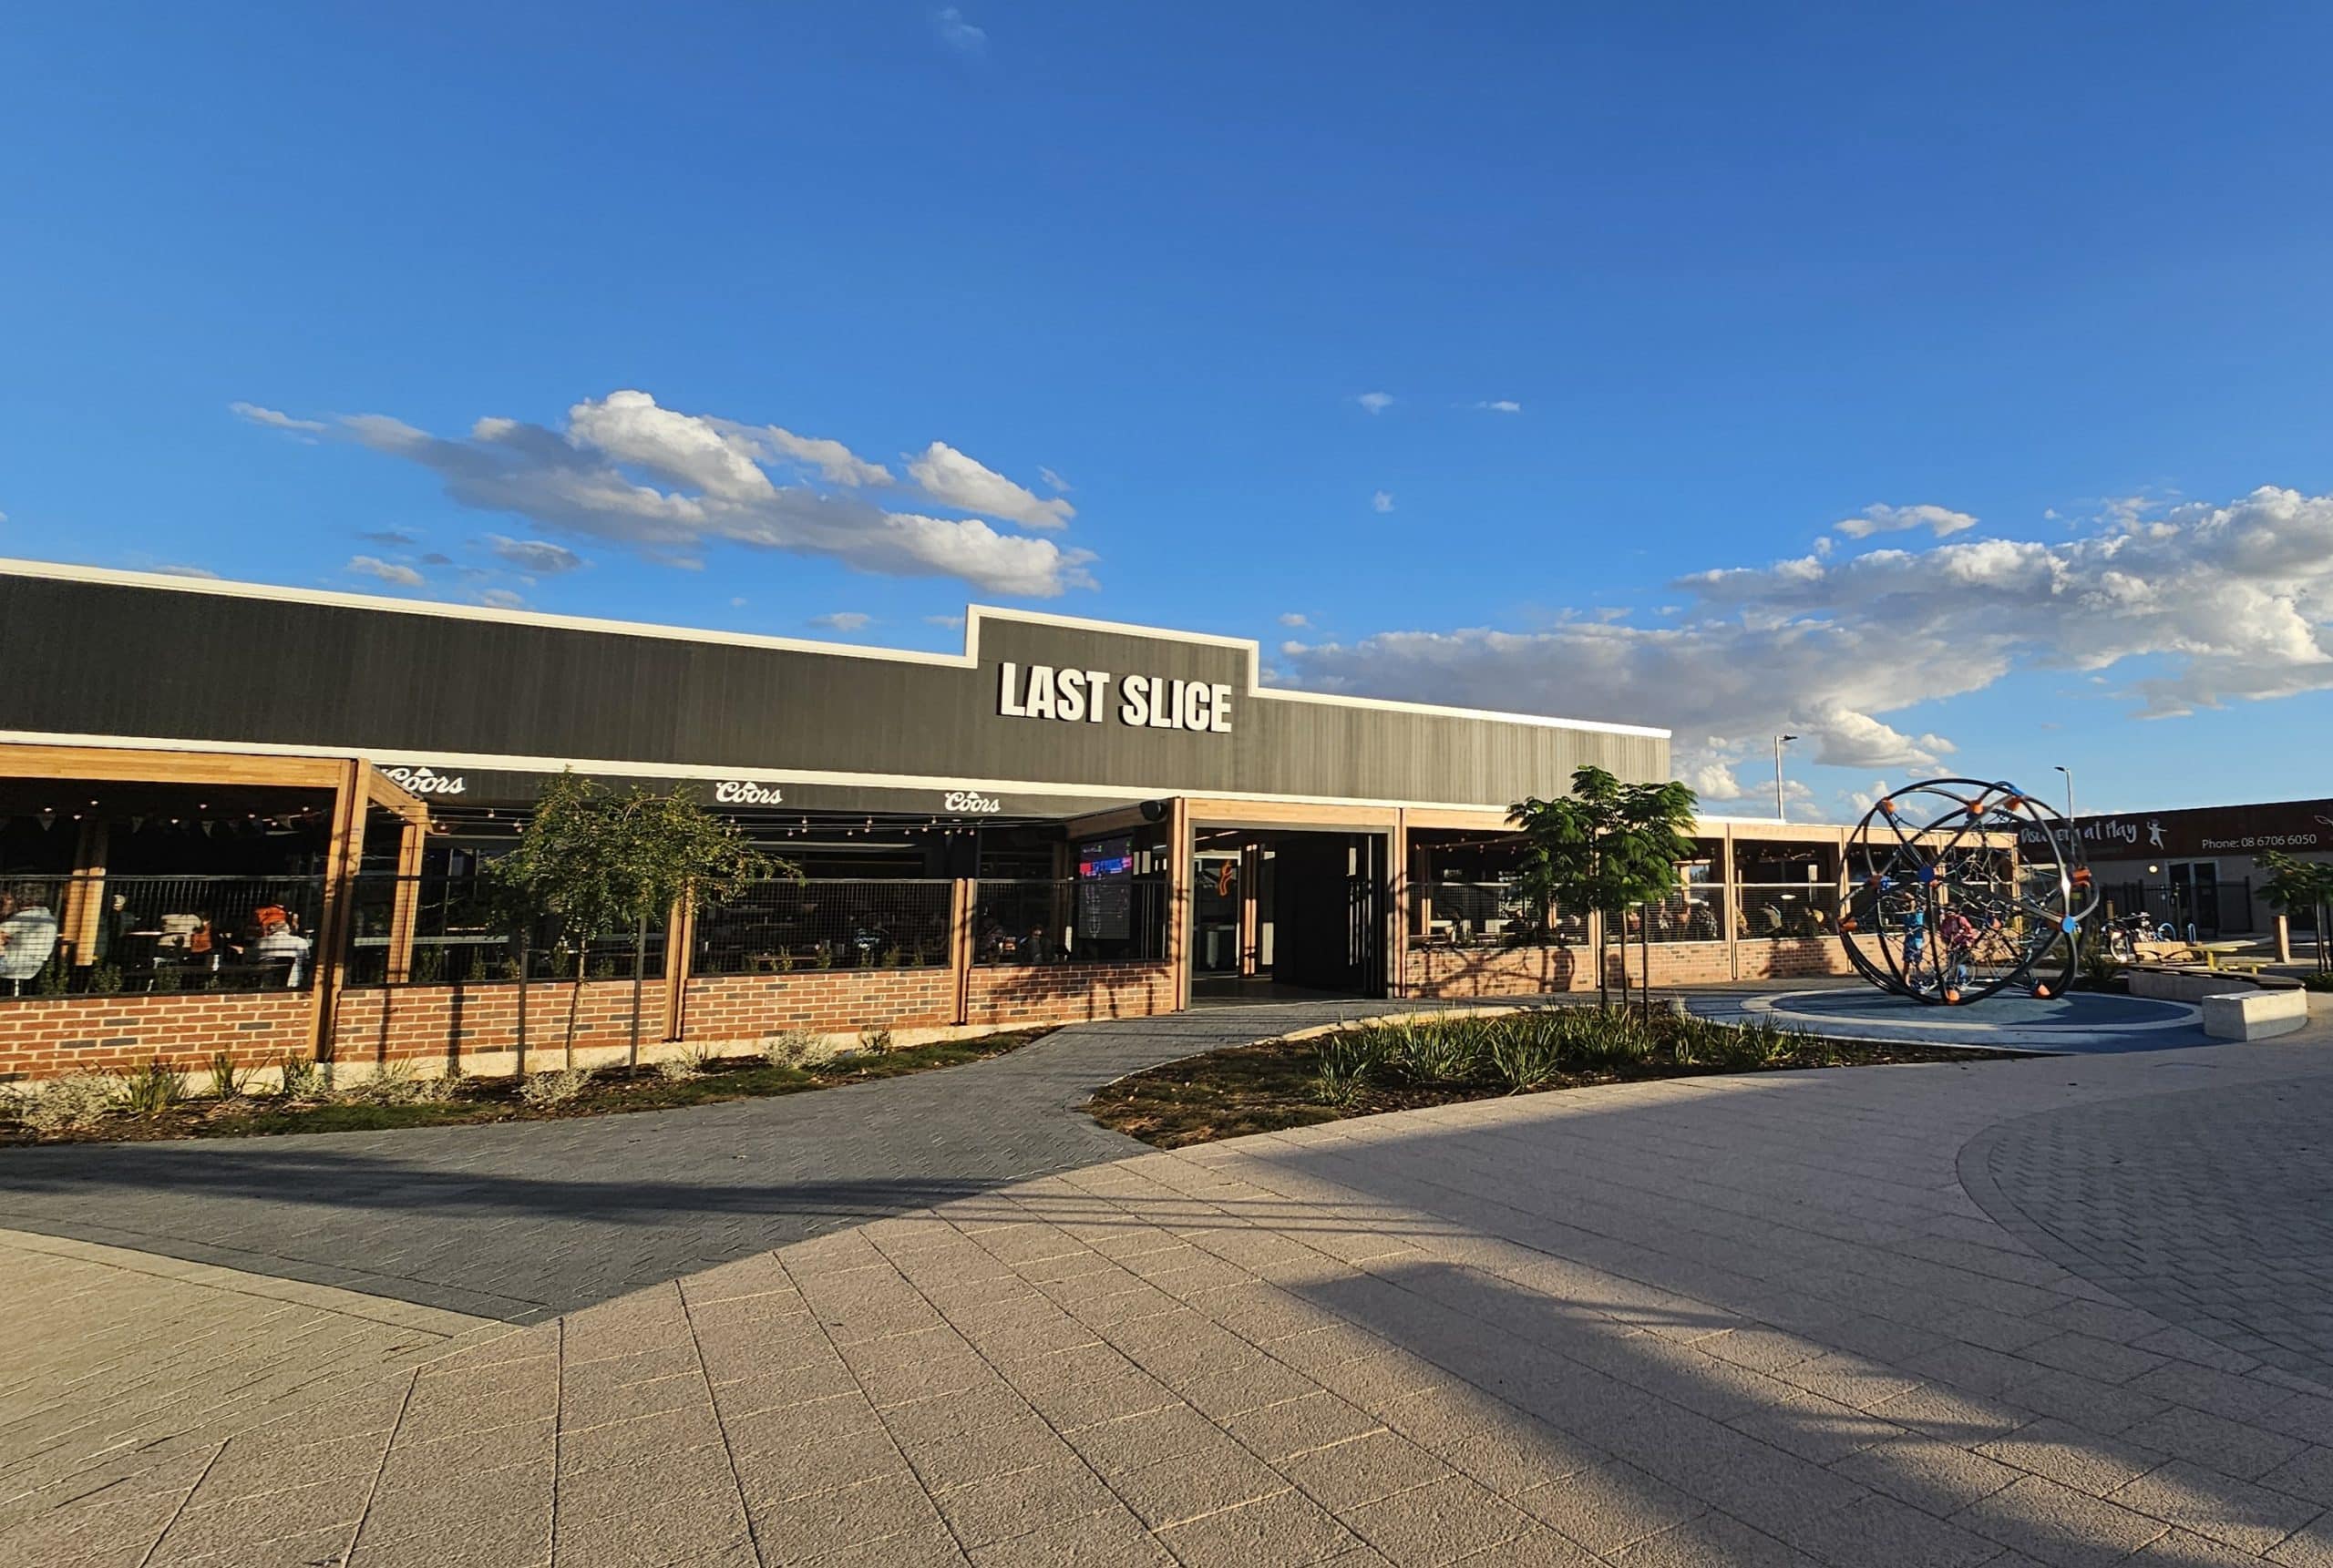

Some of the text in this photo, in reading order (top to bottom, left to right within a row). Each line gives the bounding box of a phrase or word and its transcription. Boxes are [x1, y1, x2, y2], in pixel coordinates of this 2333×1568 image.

[1000, 662, 1231, 733] LAST SLICE
[715, 781, 782, 804] Coors
[945, 791, 1000, 812] Coors
[2084, 822, 2102, 840] at
[2105, 820, 2137, 844] Play
[2202, 834, 2317, 849] Phone: 08 6706 6050
